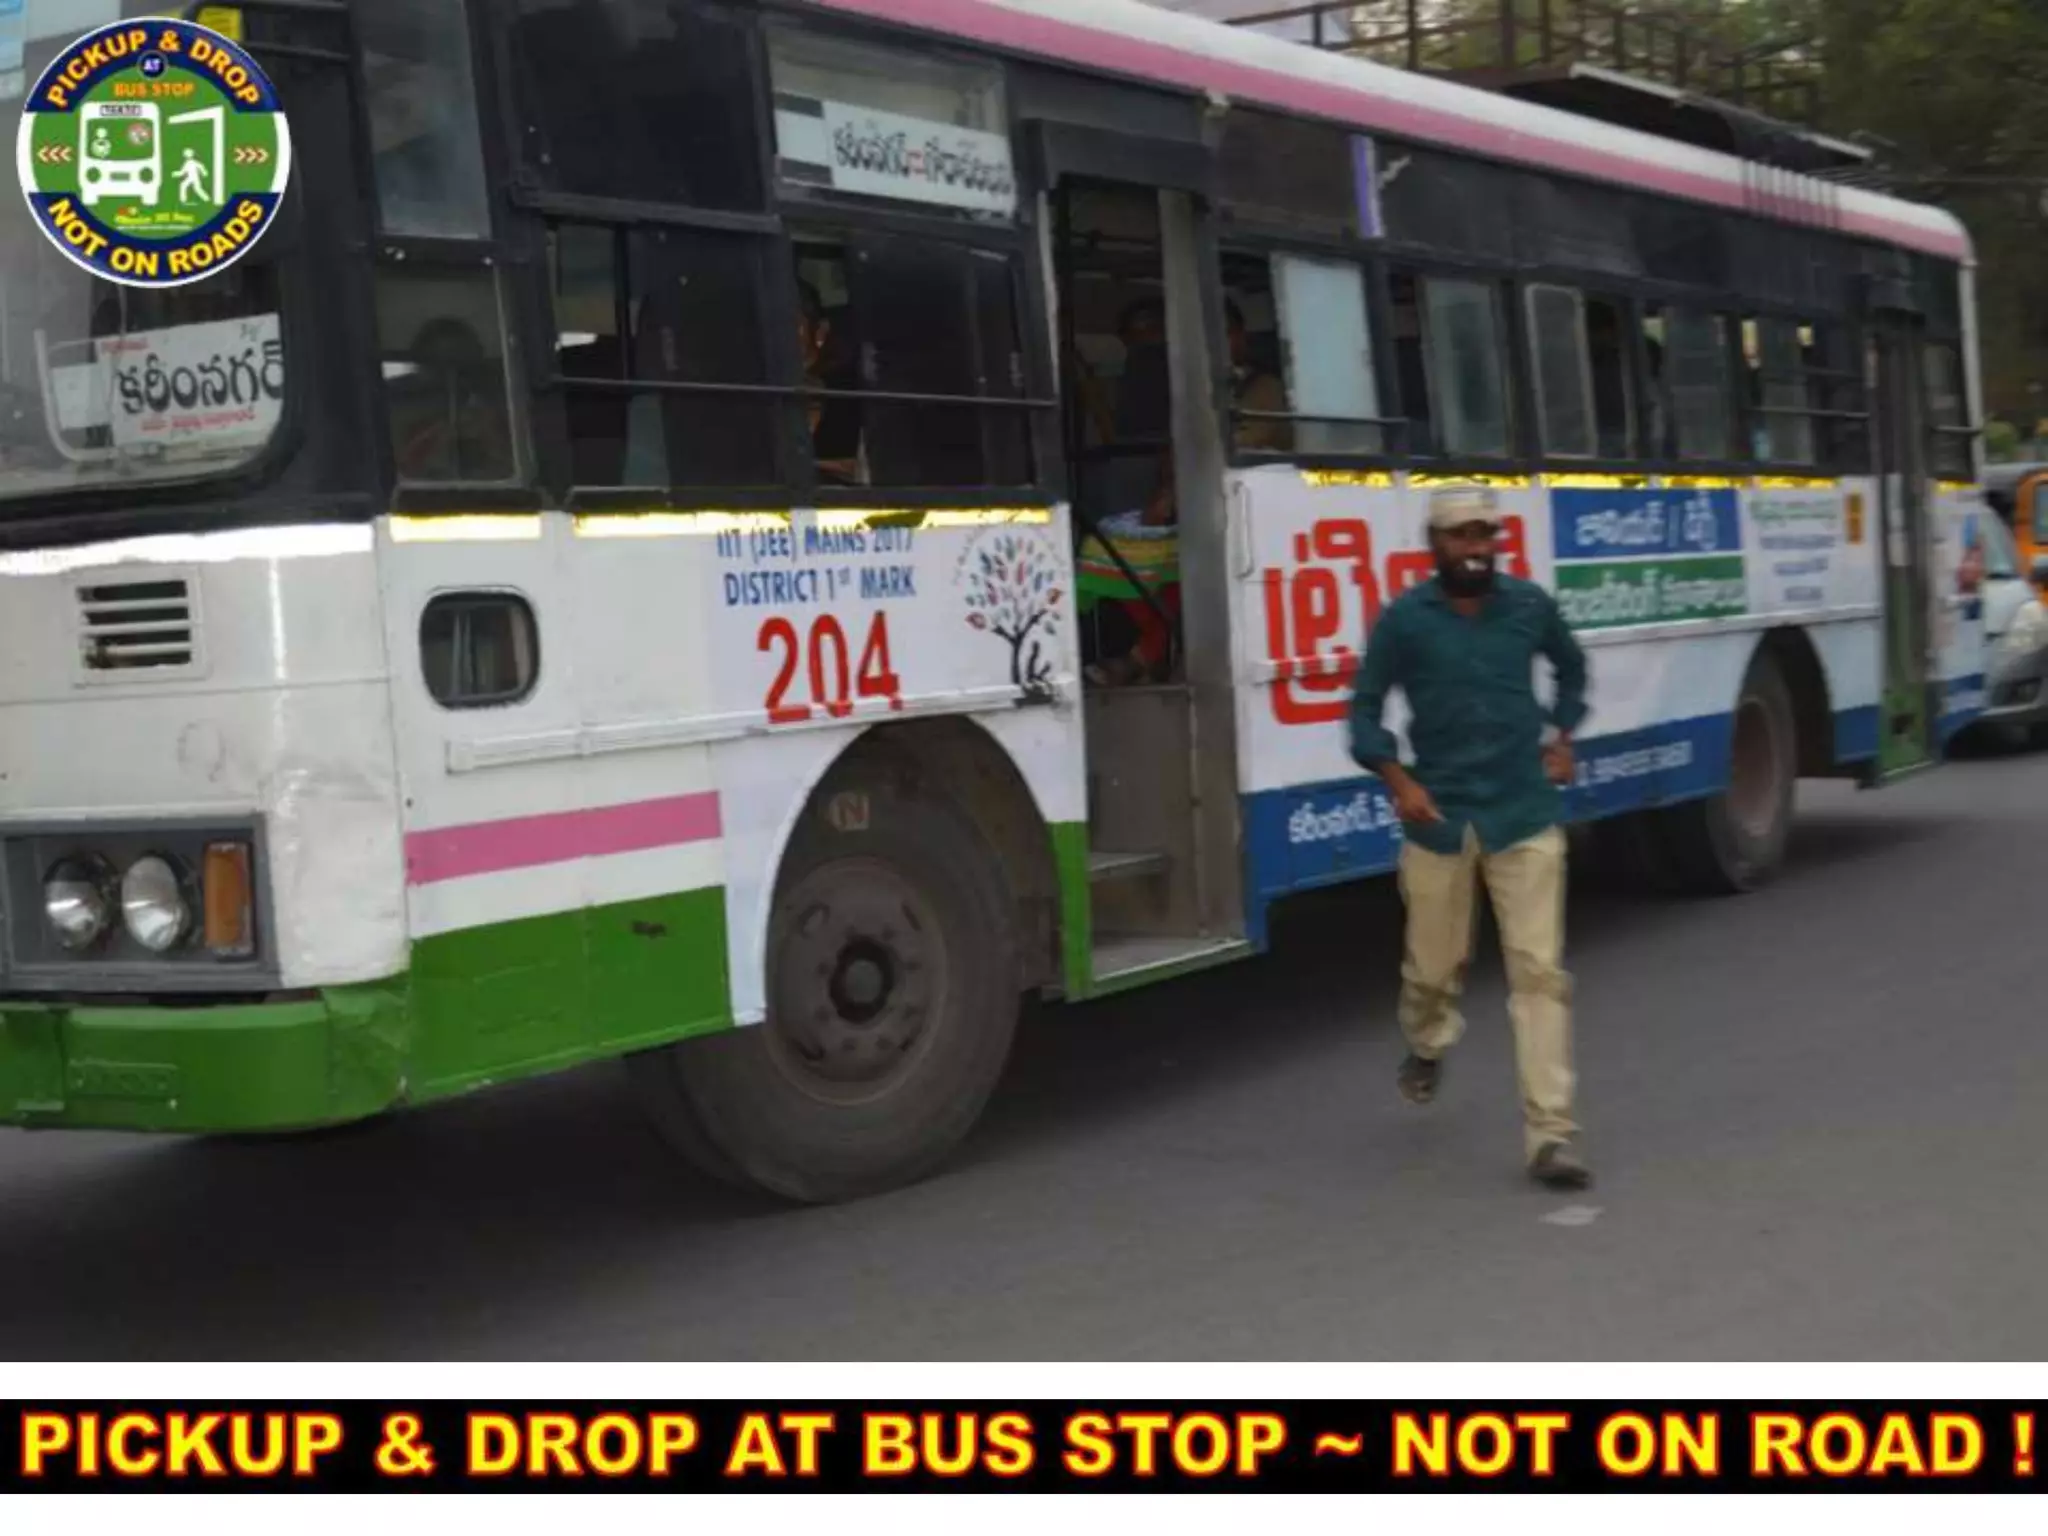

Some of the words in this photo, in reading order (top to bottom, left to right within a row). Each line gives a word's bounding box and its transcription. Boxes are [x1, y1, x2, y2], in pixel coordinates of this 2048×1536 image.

[804, 525, 866, 556] MAINS
[724, 568, 818, 607] DISTRICT
[860, 564, 917, 599] MARK
[757, 609, 903, 724] 204
